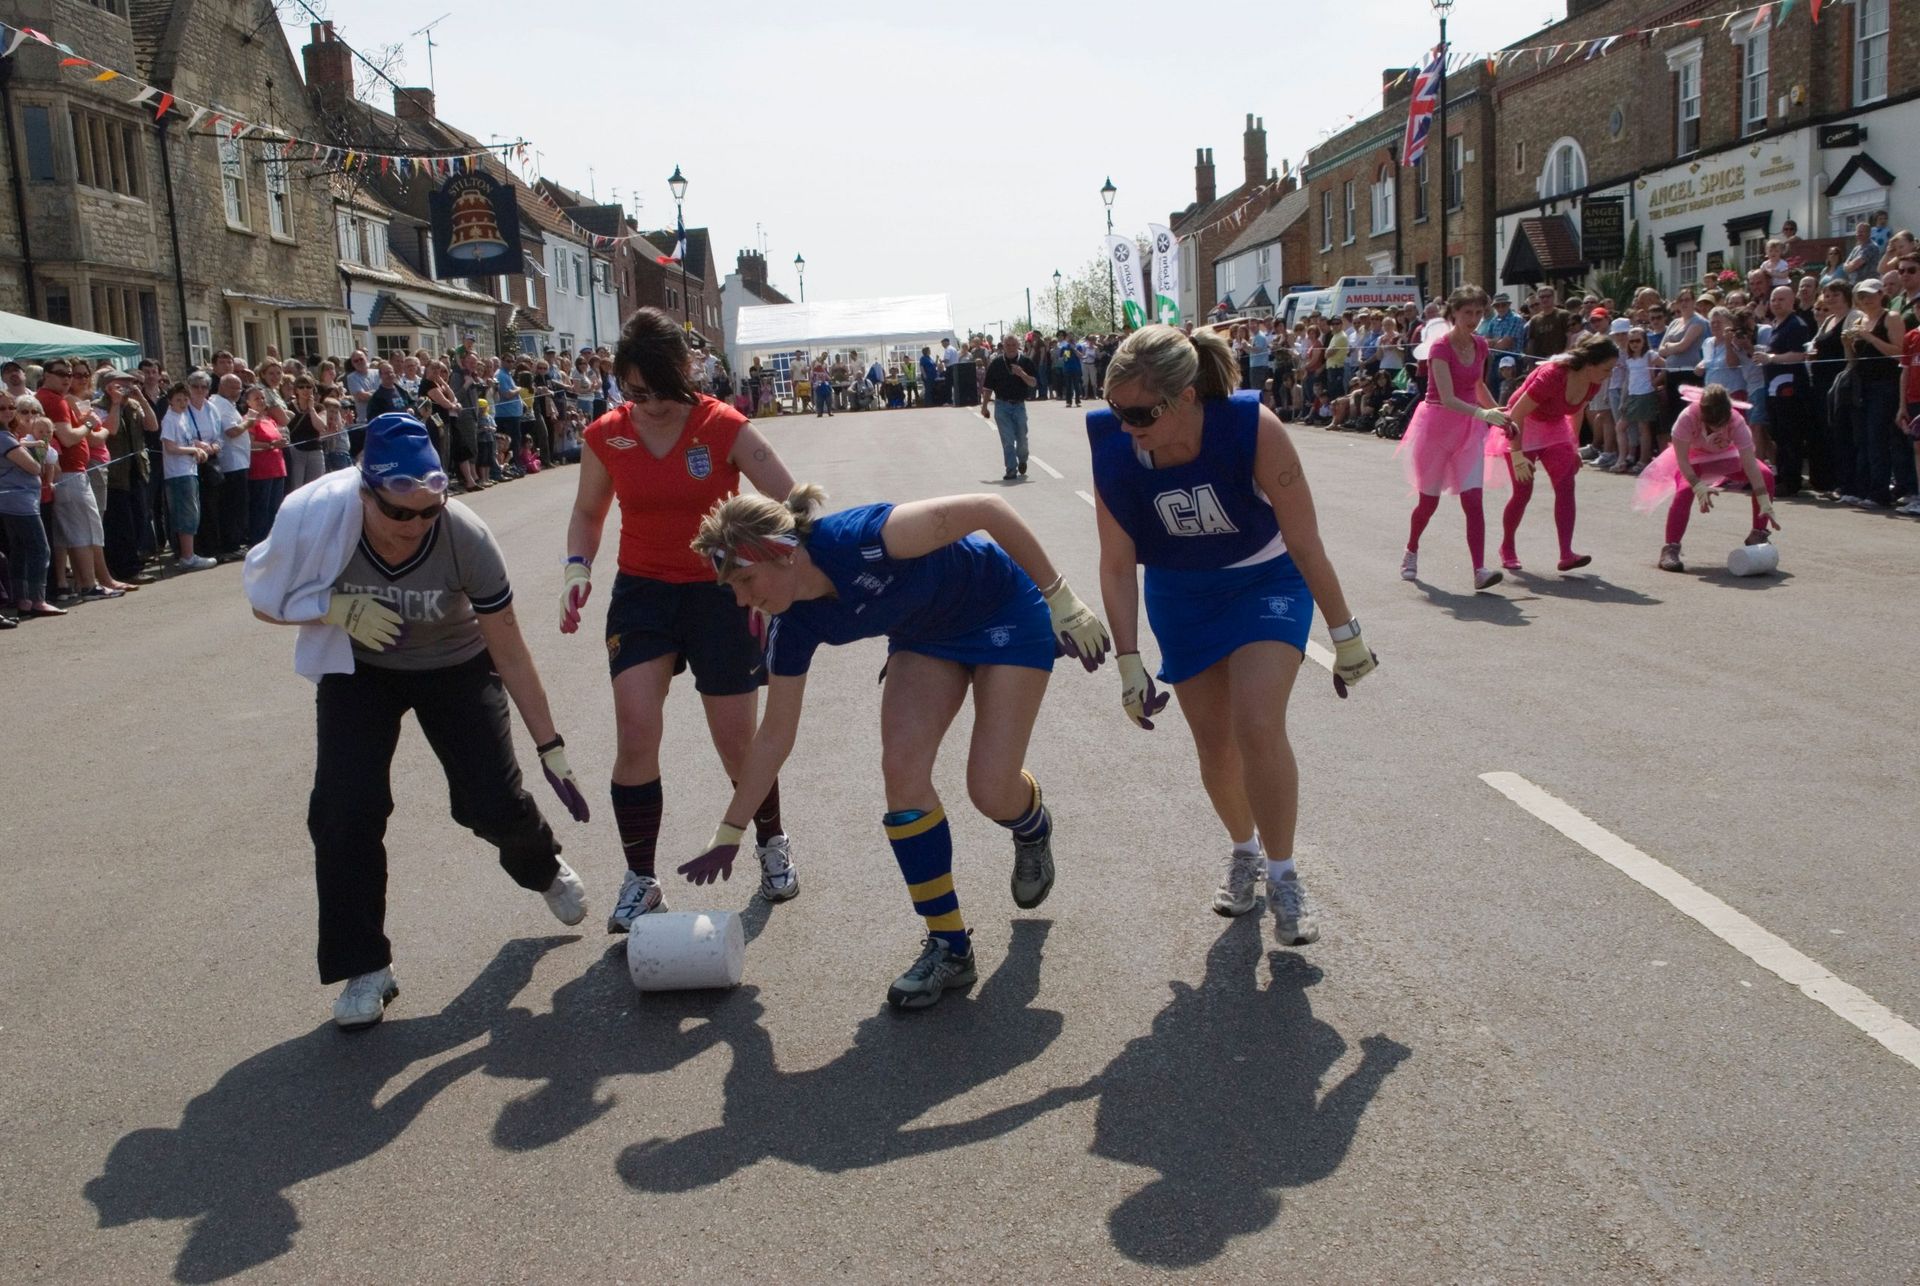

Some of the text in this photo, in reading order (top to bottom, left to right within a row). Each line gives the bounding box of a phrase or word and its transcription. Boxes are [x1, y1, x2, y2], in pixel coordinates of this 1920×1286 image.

[448, 177, 493, 196] STILTON
[1649, 180, 1696, 207] ANGEL
[1700, 164, 1745, 195] SPICE
[1583, 207, 1621, 217] ANGEL
[1585, 217, 1618, 227] SPICE
[1346, 293, 1415, 304] AMBULANCE
[1154, 483, 1240, 537] GA
